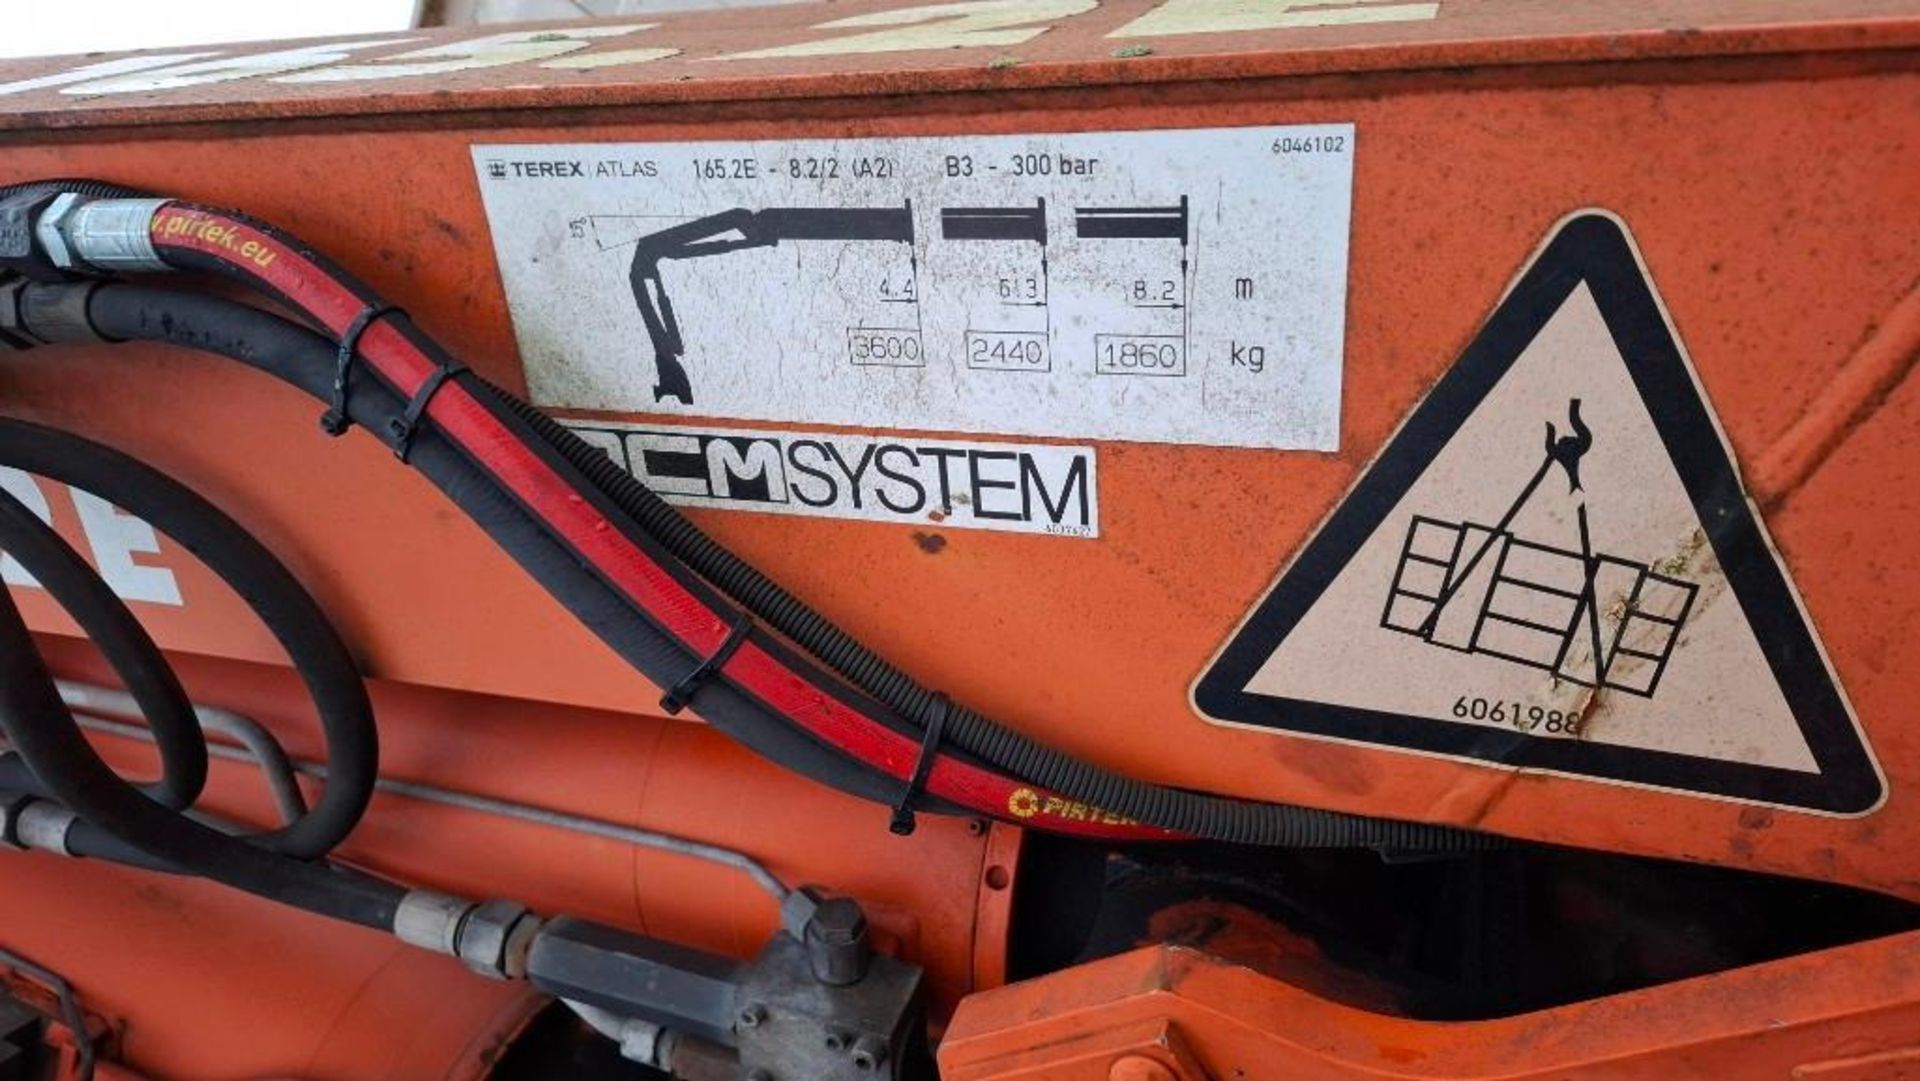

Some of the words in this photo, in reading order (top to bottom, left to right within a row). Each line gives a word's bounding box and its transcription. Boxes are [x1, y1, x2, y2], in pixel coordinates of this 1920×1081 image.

[1271, 136, 1345, 154] 6046102
[512, 162, 584, 178] TEREX
[596, 161, 659, 178] ATLAS
[693, 157, 757, 180] 165.2E
[789, 157, 840, 180] 8.2/2
[852, 157, 894, 179] (A2)
[946, 155, 974, 177] B3
[1012, 154, 1051, 176] 300
[1059, 153, 1098, 176] bar
[879, 279, 914, 298] 4.4
[1133, 280, 1176, 301] 8.2
[1235, 277, 1254, 300] m
[853, 335, 919, 361] 3600
[971, 339, 1043, 365] 2440
[1104, 342, 1177, 369] 1860
[1230, 341, 1265, 372] kg
[1452, 695, 1580, 735] 6061988
